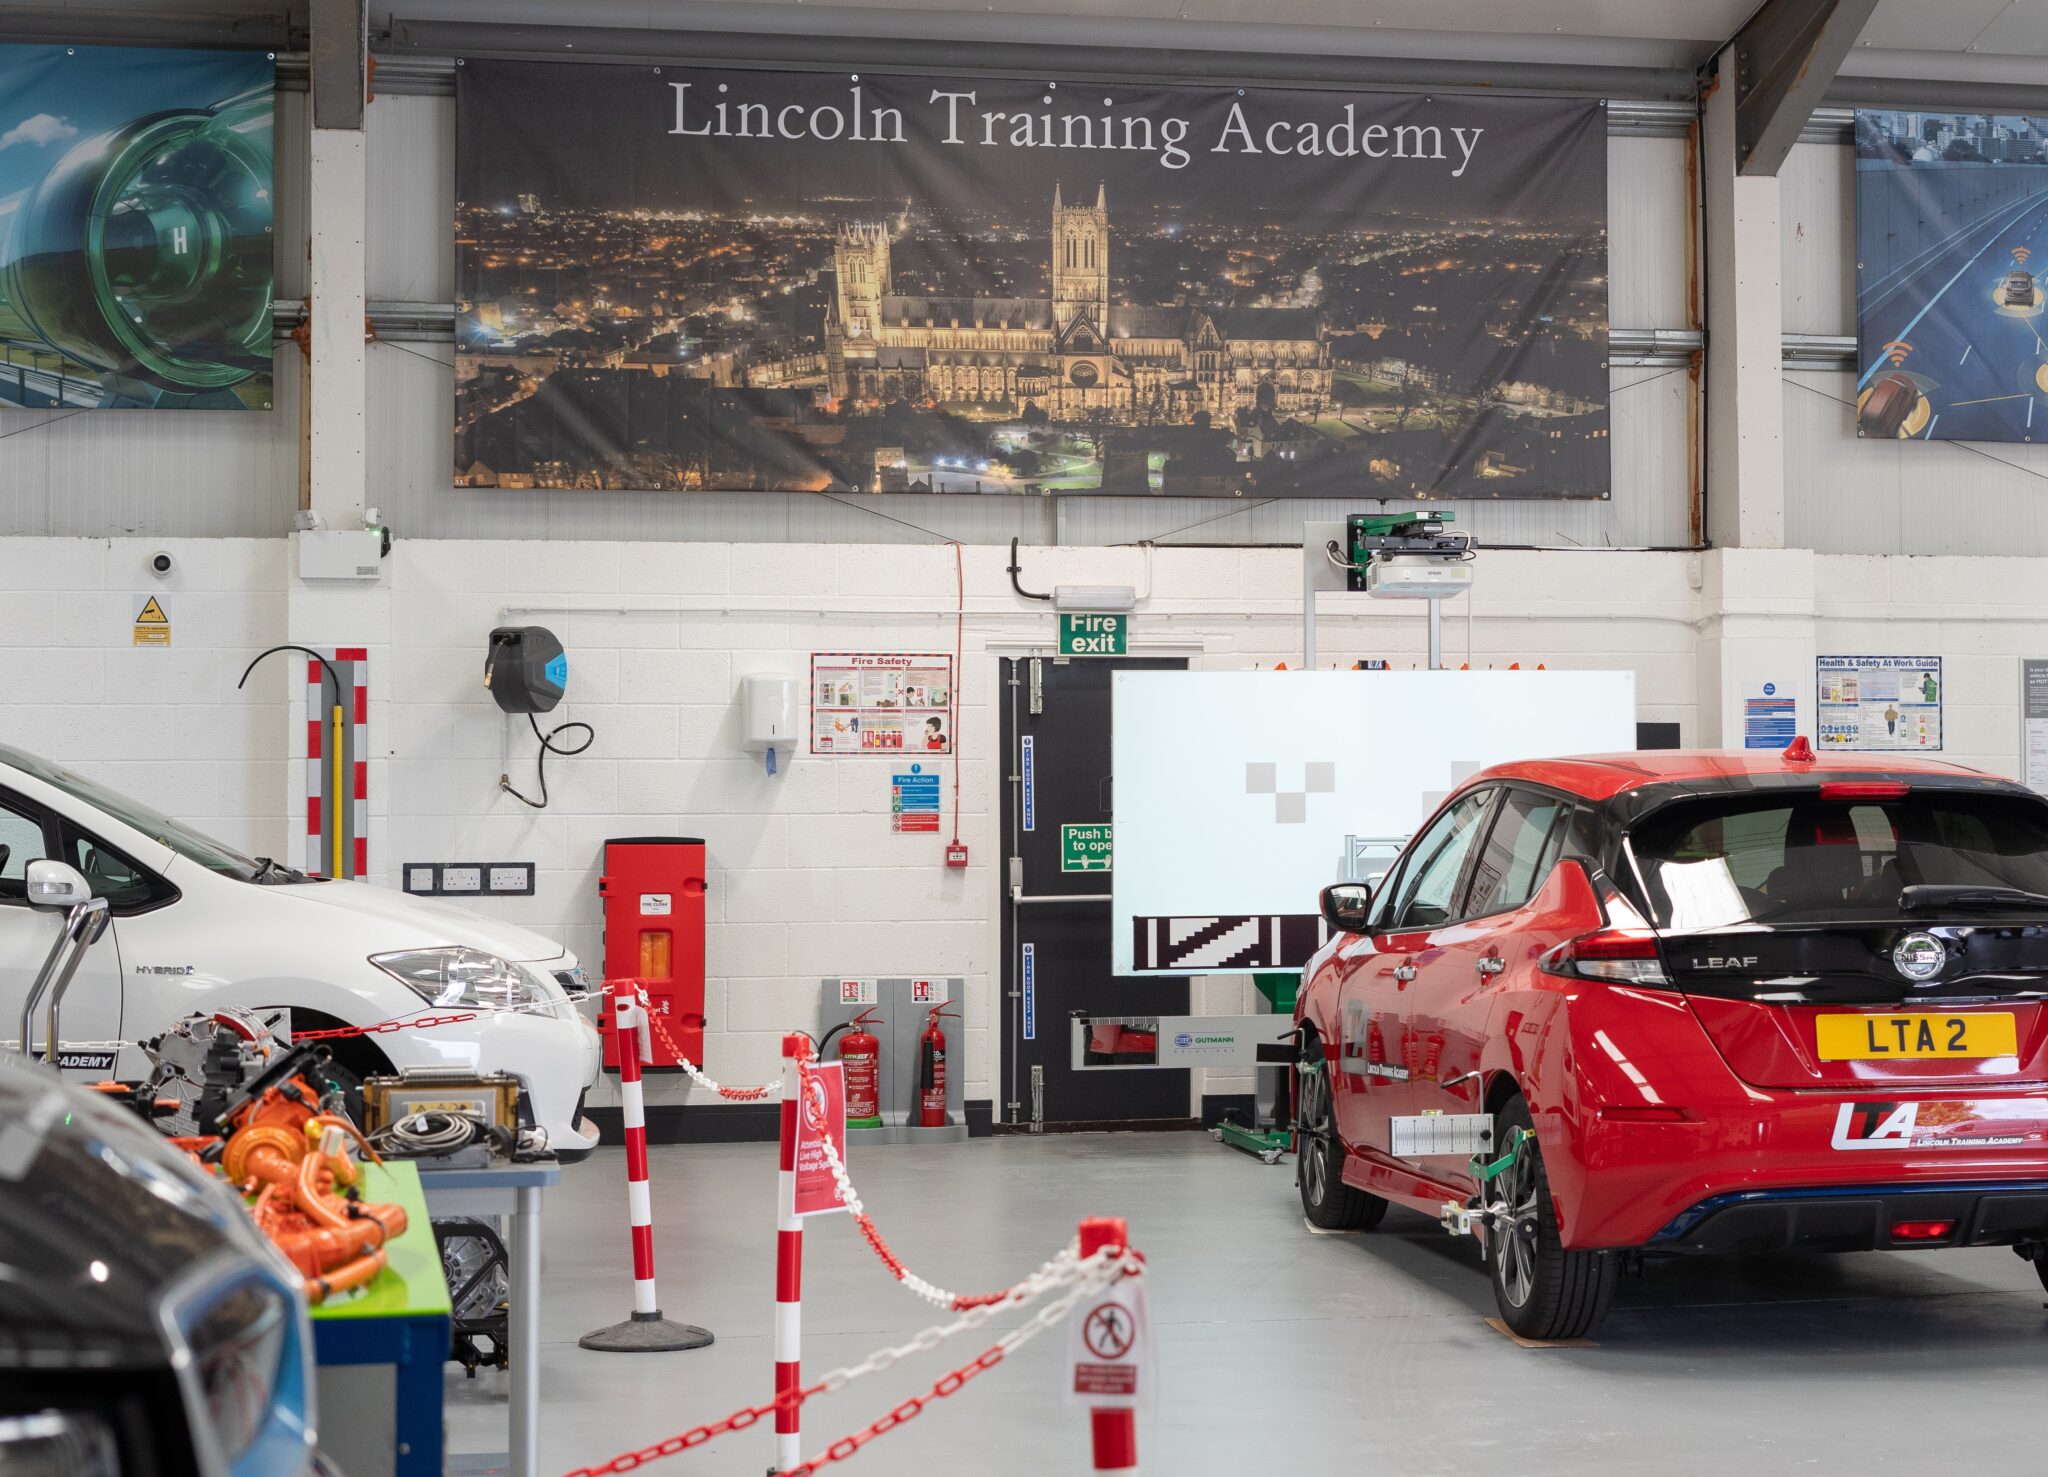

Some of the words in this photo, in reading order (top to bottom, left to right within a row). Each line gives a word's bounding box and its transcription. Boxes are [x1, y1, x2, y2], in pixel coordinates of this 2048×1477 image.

[668, 82, 907, 142] Lincoln
[929, 89, 1190, 169] Training
[1211, 102, 1484, 177] Academy
[174, 226, 187, 254] H
[1070, 613, 1117, 632] Fire
[1071, 633, 1115, 652] exit
[851, 657, 873, 665] Fire
[876, 657, 912, 667] Safety
[1819, 659, 1845, 667] Health
[1847, 659, 1853, 667] &
[1855, 659, 1880, 668] Safety
[1883, 659, 1892, 667] At
[1893, 659, 1914, 667] Work
[1915, 659, 1938, 667] Guide
[1068, 828, 1101, 840] Push
[1072, 840, 1086, 851] to
[1089, 842, 1112, 853] ope
[1692, 956, 1758, 969] LEAF
[1901, 953, 1940, 961] NISSAN
[135, 965, 185, 975] HYBRID
[1194, 1036, 1234, 1044] GUTMANN
[1867, 1019, 1936, 1052] LTA
[1946, 1018, 1967, 1051] 2
[1831, 1102, 1919, 1150] LTA
